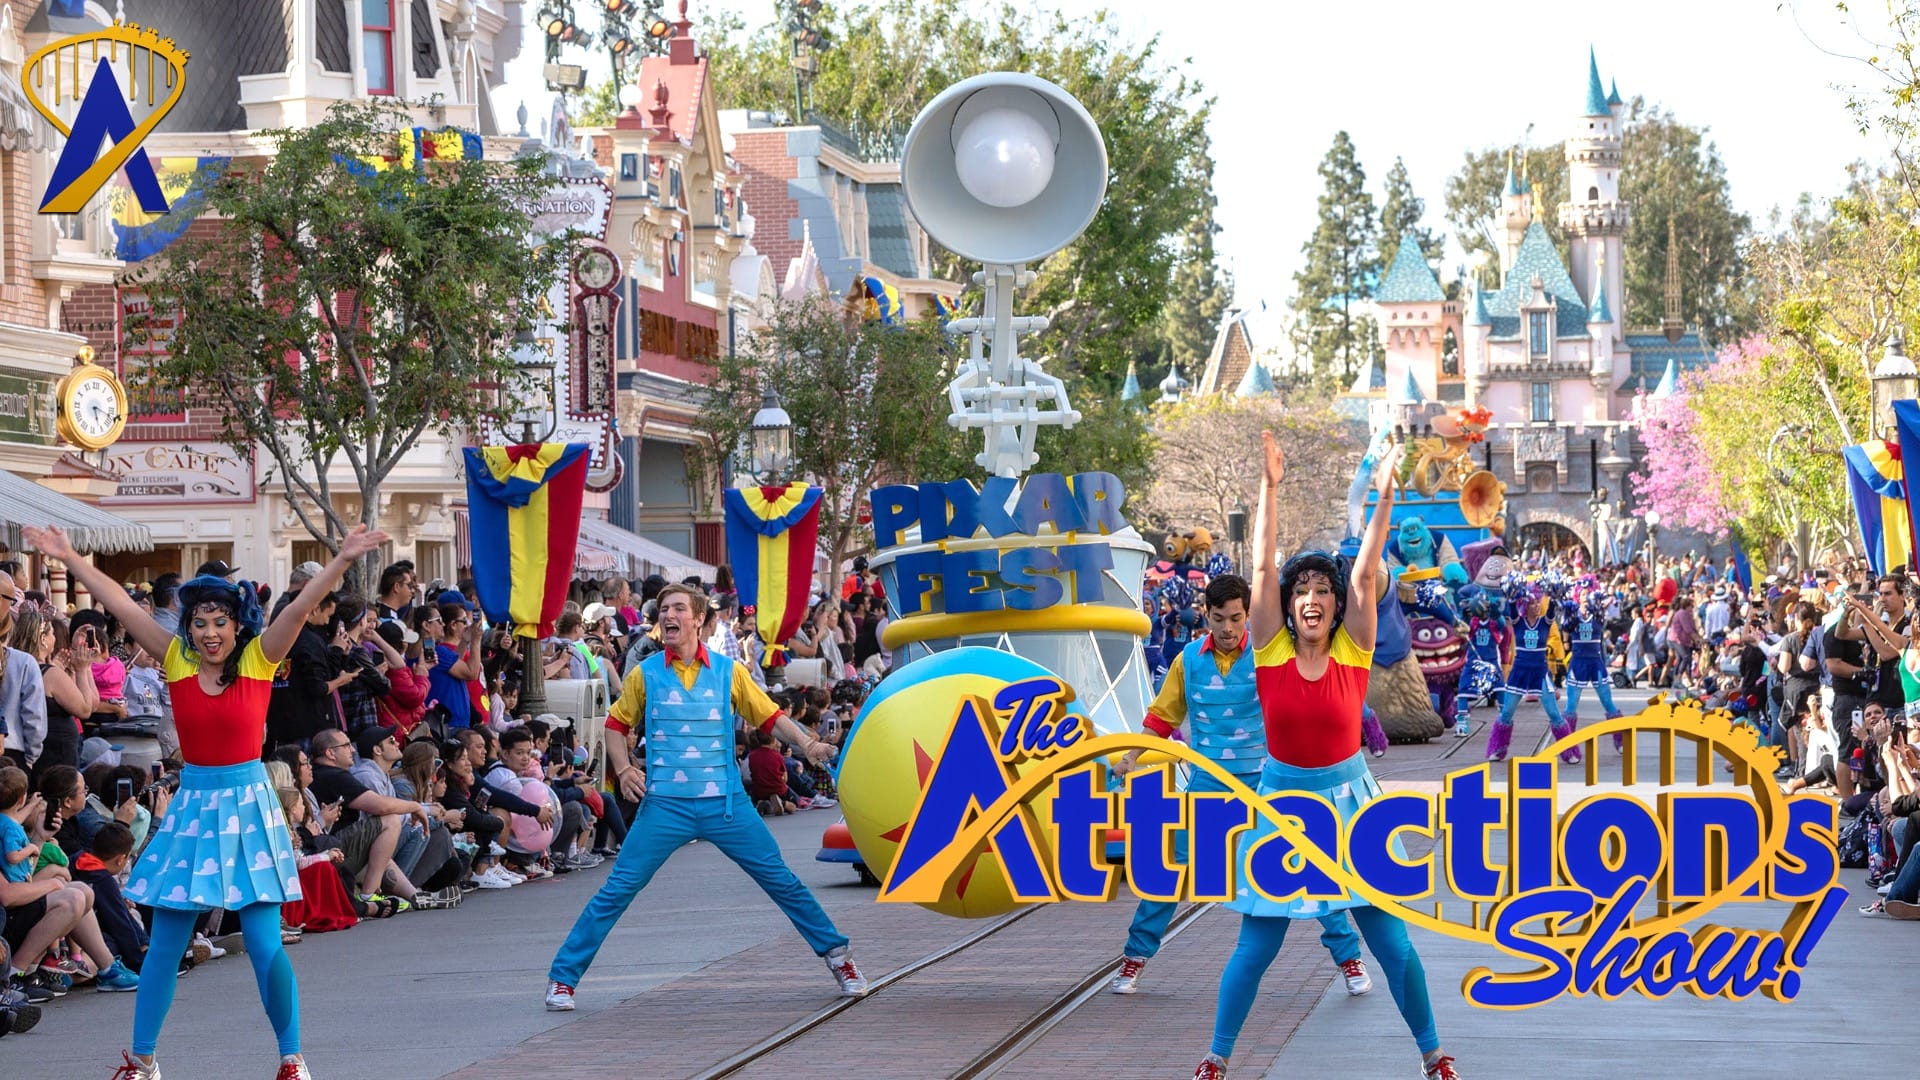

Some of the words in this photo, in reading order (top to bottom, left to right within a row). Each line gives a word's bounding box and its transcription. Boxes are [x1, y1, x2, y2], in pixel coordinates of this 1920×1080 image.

[500, 199, 595, 217] ARNATION
[122, 486, 150, 495] FARE
[870, 471, 1130, 549] PIXAR
[895, 543, 1114, 615] FEST
